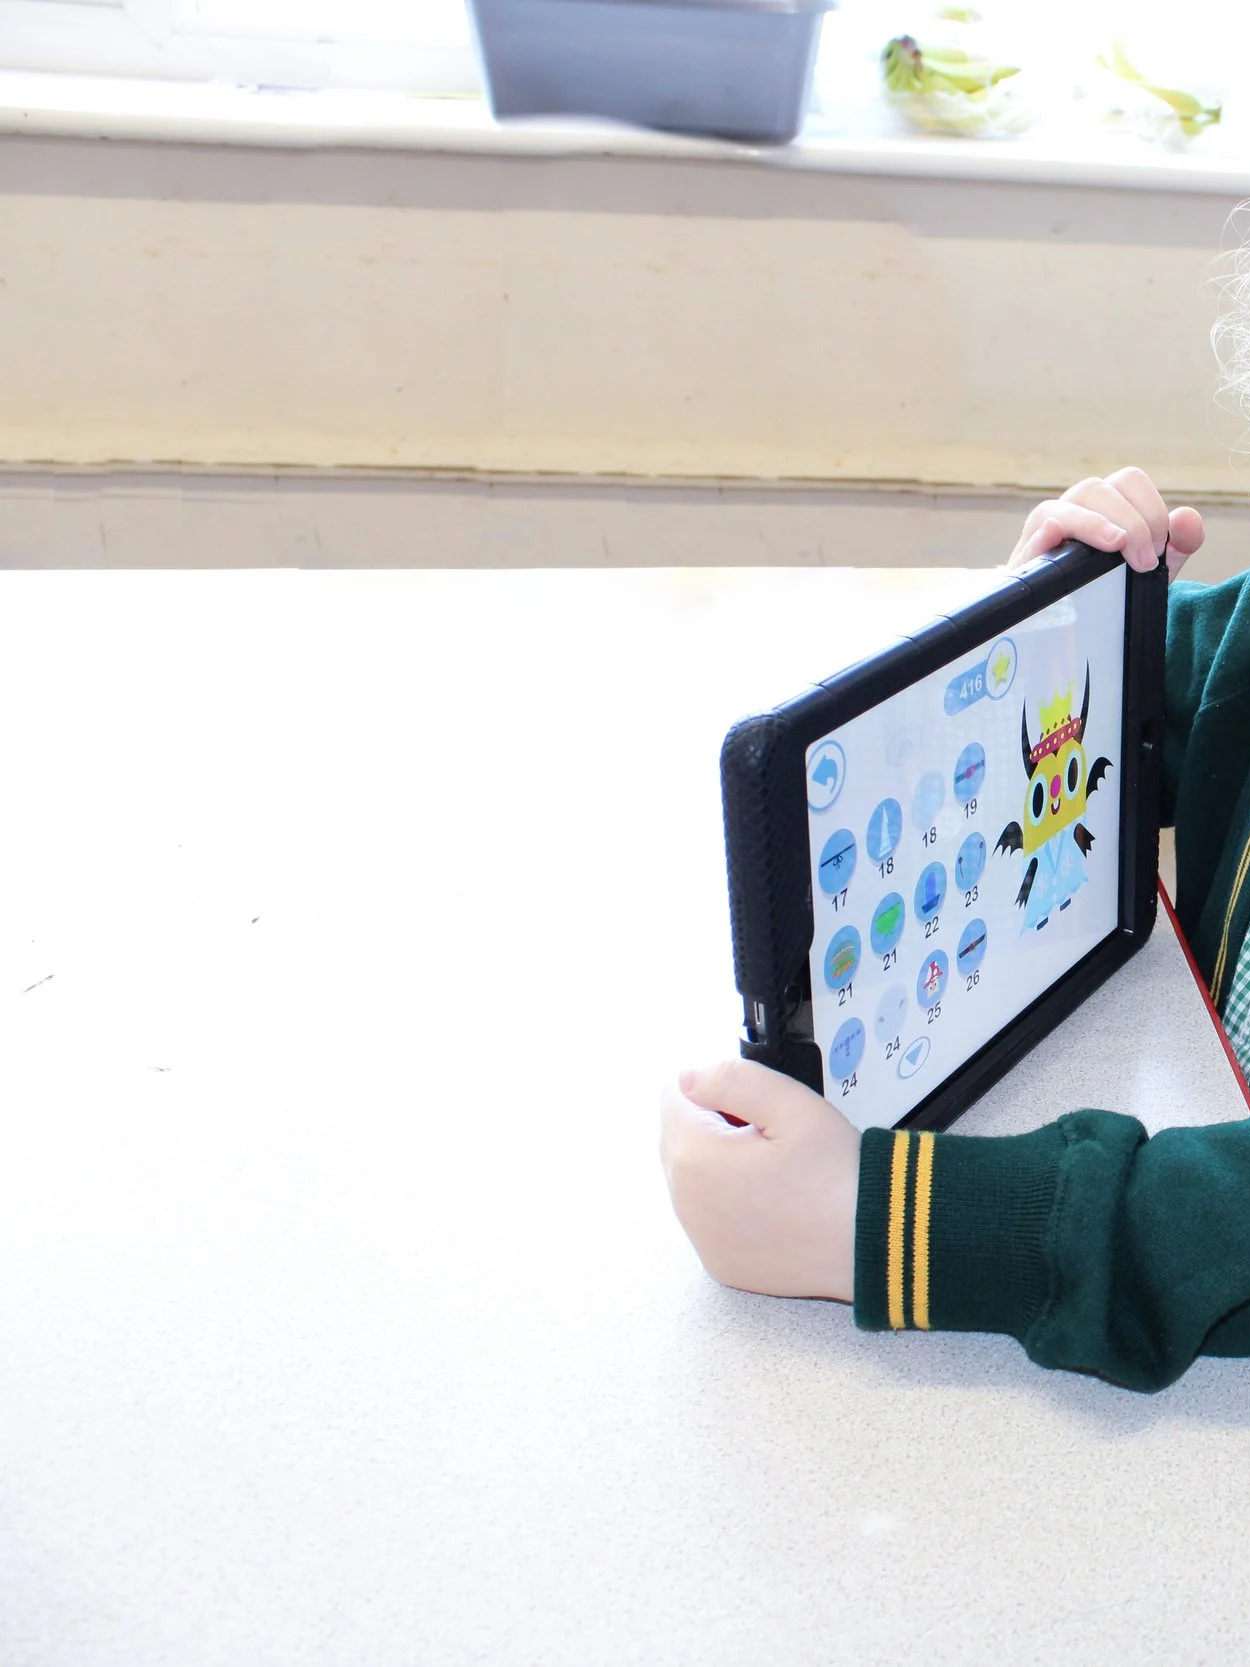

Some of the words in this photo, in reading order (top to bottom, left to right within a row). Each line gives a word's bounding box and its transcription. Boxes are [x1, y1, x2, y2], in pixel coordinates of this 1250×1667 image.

[960, 674, 983, 699] 416
[963, 798, 977, 819] 19
[922, 826, 937, 848] 18
[879, 856, 894, 879] 18
[832, 888, 848, 912] 17
[964, 885, 979, 908] 23
[925, 916, 939, 939] 22
[882, 948, 897, 971] 21
[966, 969, 980, 992] 26
[838, 982, 853, 1007] 21
[927, 1001, 942, 1025] 25
[885, 1036, 901, 1060] 24
[842, 1072, 858, 1097] 24
